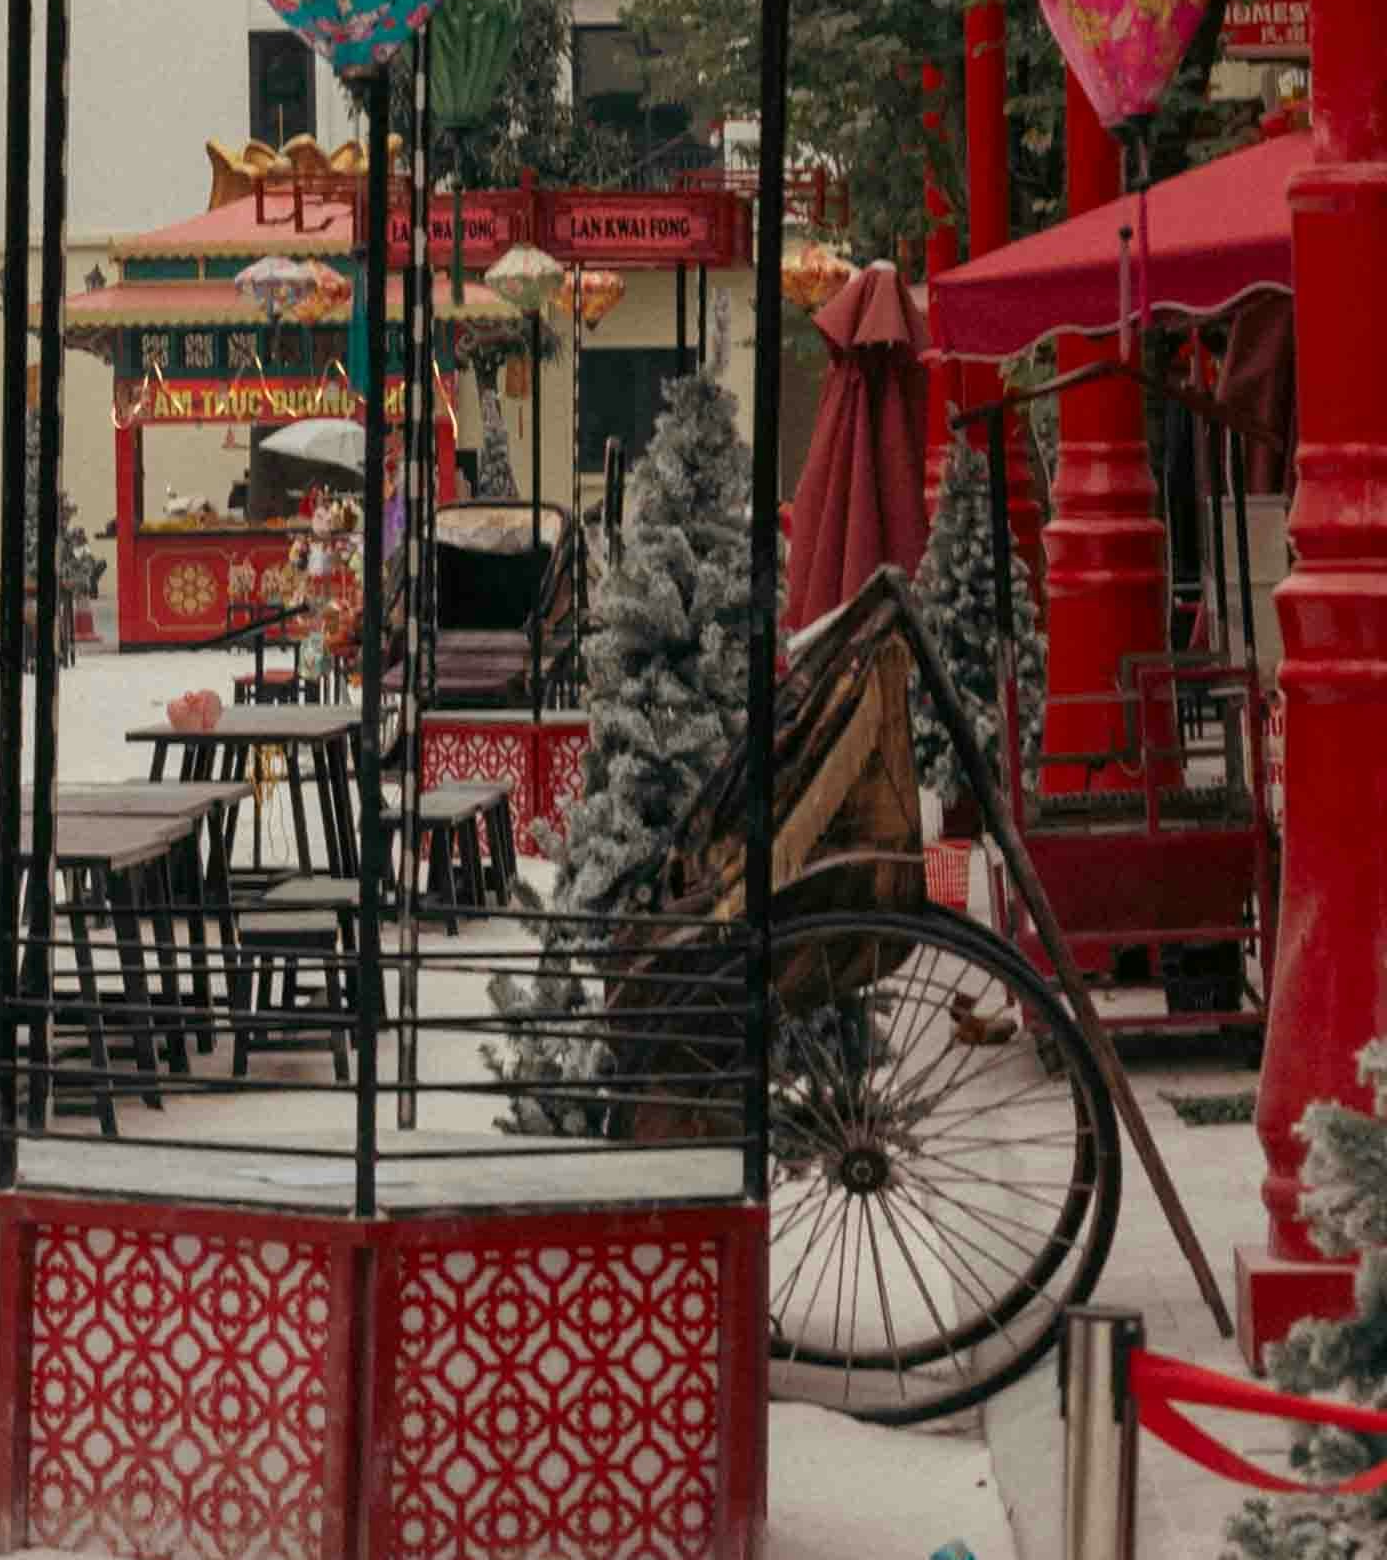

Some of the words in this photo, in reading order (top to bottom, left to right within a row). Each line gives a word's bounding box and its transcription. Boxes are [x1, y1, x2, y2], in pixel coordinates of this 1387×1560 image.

[571, 217, 601, 241] LAN
[604, 217, 646, 241] KWAI
[650, 216, 691, 238] FONG
